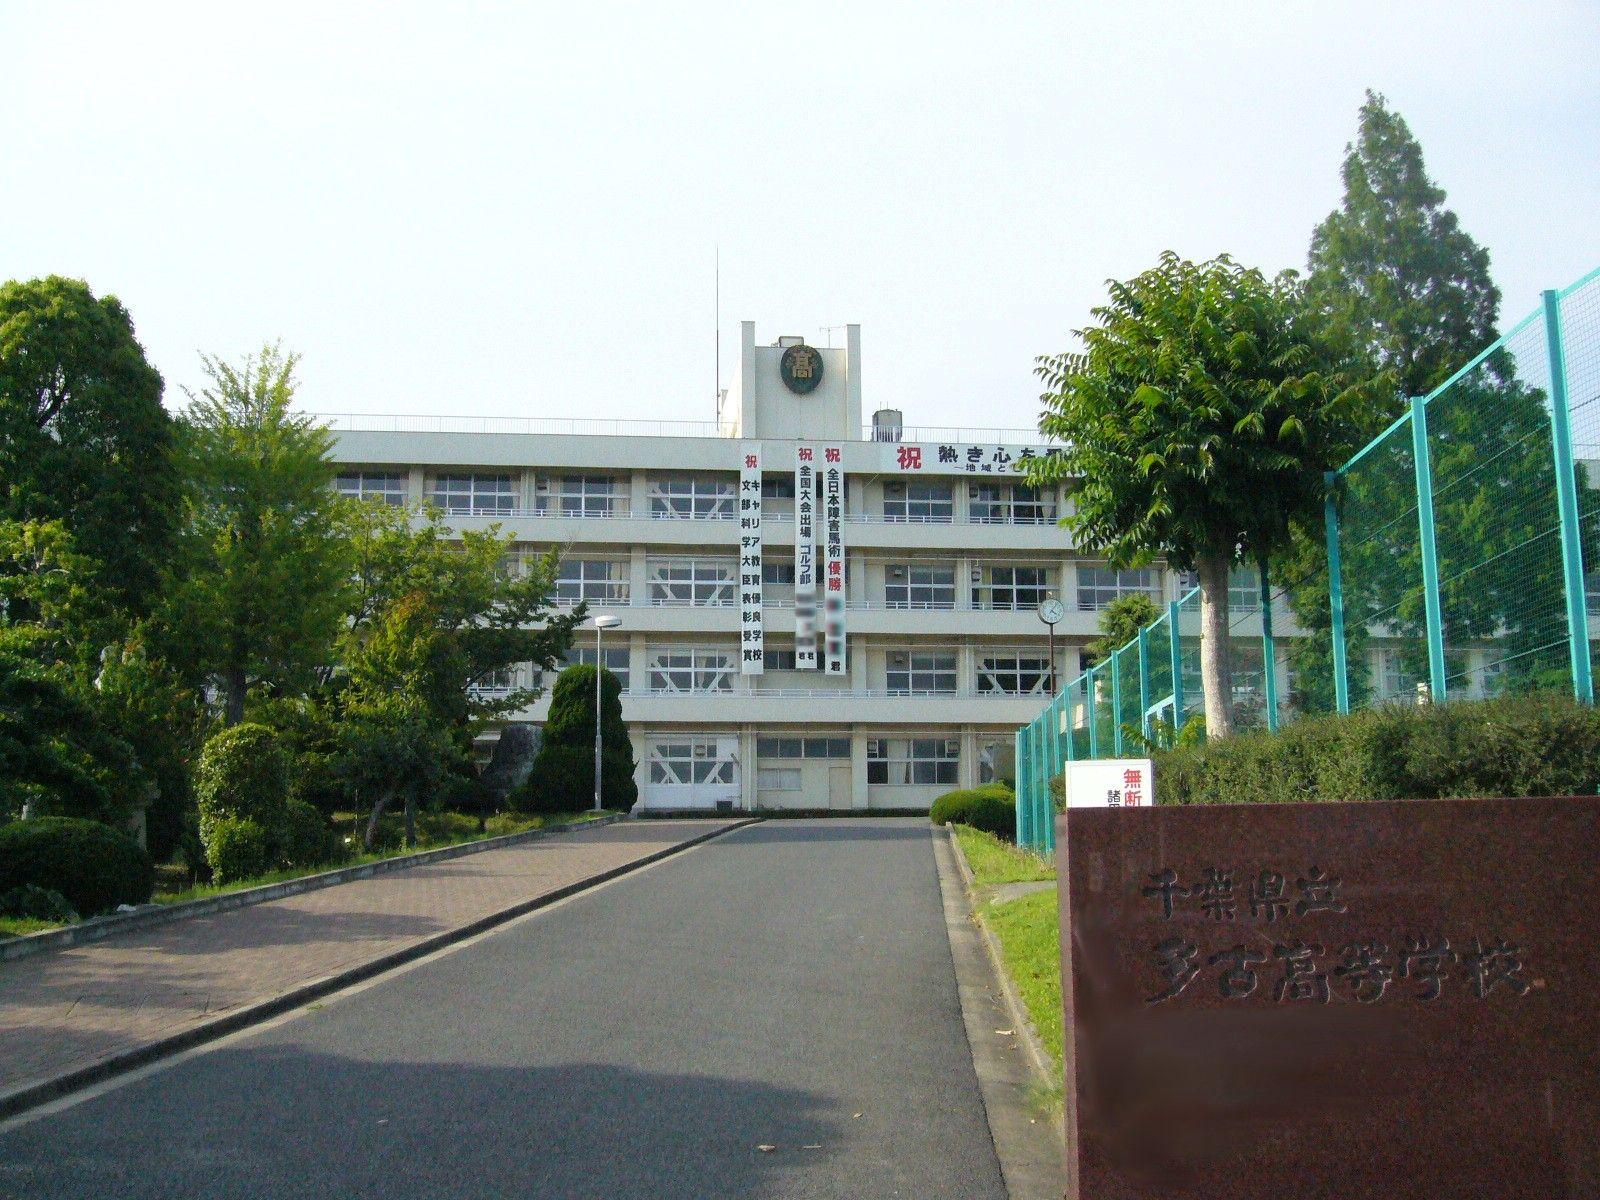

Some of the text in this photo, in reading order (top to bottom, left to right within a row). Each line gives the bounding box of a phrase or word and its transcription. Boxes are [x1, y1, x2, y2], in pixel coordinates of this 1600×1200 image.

[745, 454, 758, 469] 祝
[798, 447, 813, 461] 祝
[825, 448, 841, 463] 祝
[896, 445, 1062, 470] 祝 熱き心を
[799, 465, 812, 538] 全国大会出場
[751, 480, 762, 661] キャリア教育優良学校
[1107, 789, 1121, 807] 諸
[1123, 768, 1142, 807] 無断
[1142, 866, 1347, 921] 千葉県立
[1144, 935, 1532, 1006] 多古高等学校
